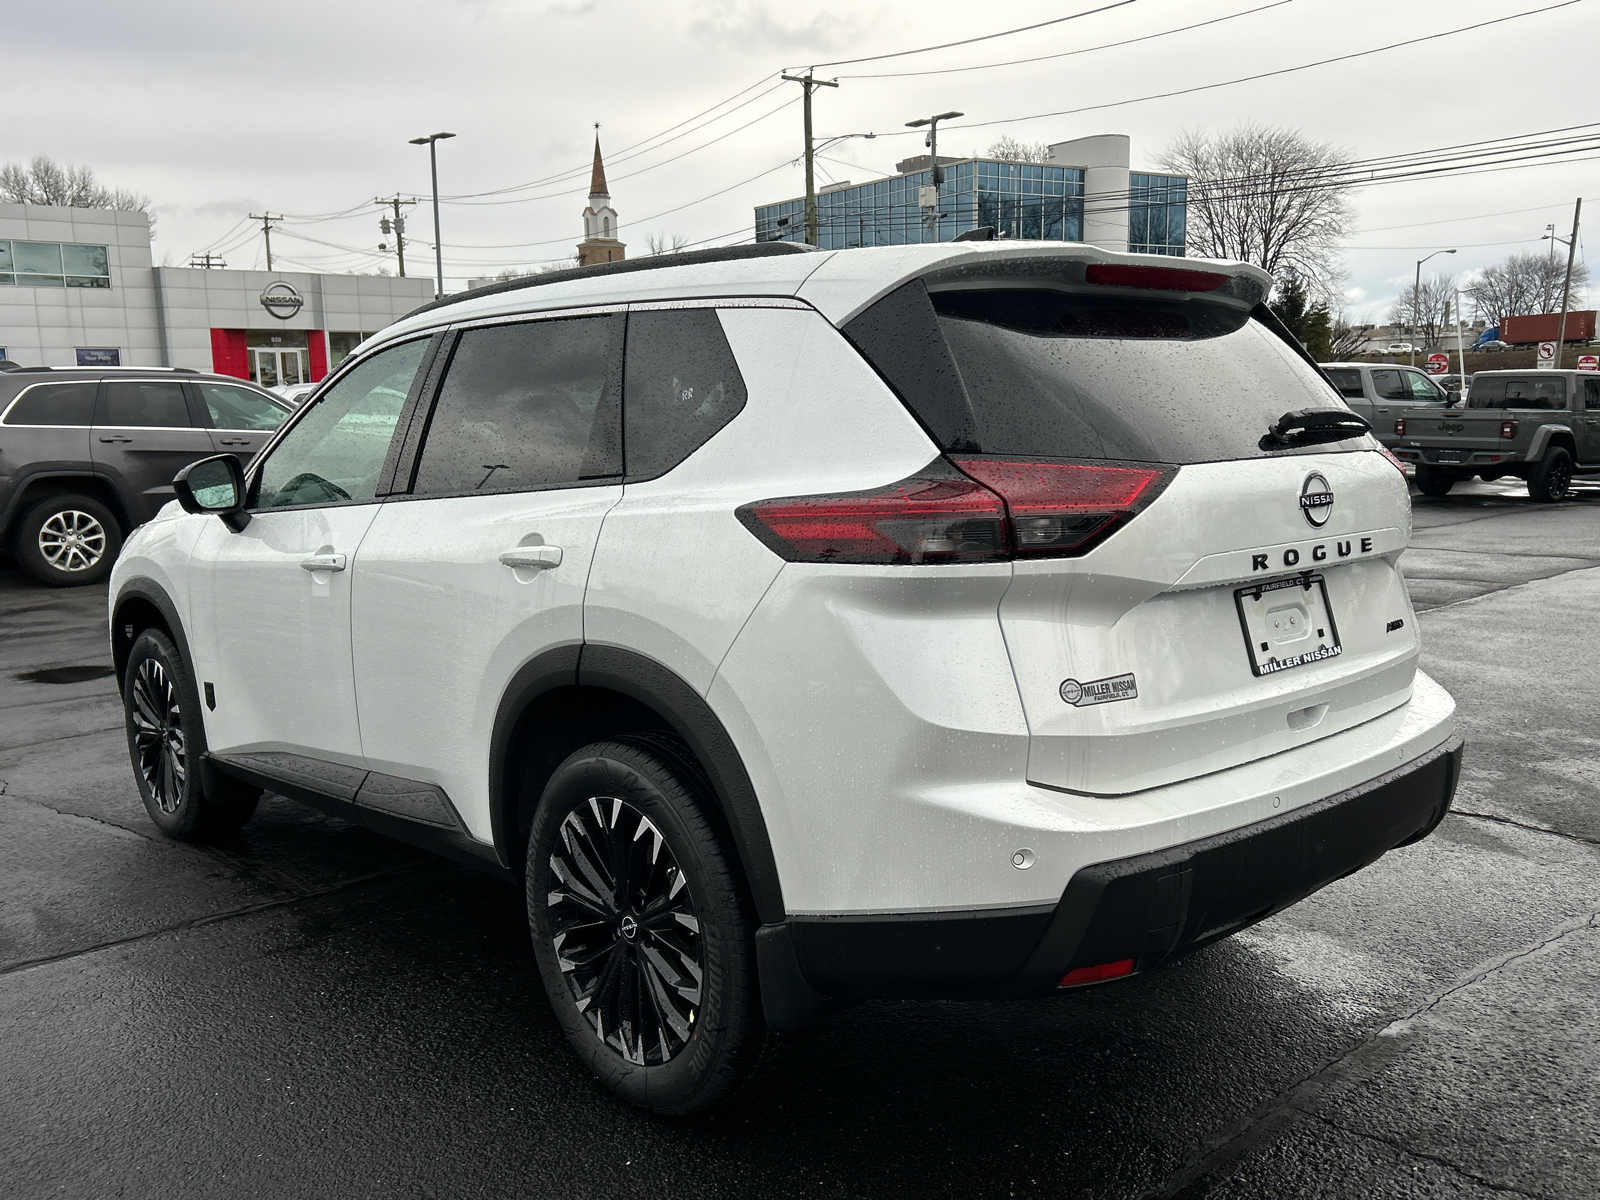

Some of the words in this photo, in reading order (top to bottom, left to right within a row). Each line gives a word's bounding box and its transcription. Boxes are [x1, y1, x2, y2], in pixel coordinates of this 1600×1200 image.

[1438, 421, 1464, 433] Jeep
[1301, 495, 1334, 506] NISSAN
[1252, 537, 1373, 572] ROGUE
[1385, 618, 1405, 633] AWD
[1259, 657, 1301, 675] MILLER
[1303, 645, 1341, 662] NISSAN
[1083, 683, 1111, 697] MILLER
[1112, 680, 1137, 692] NISSAN
